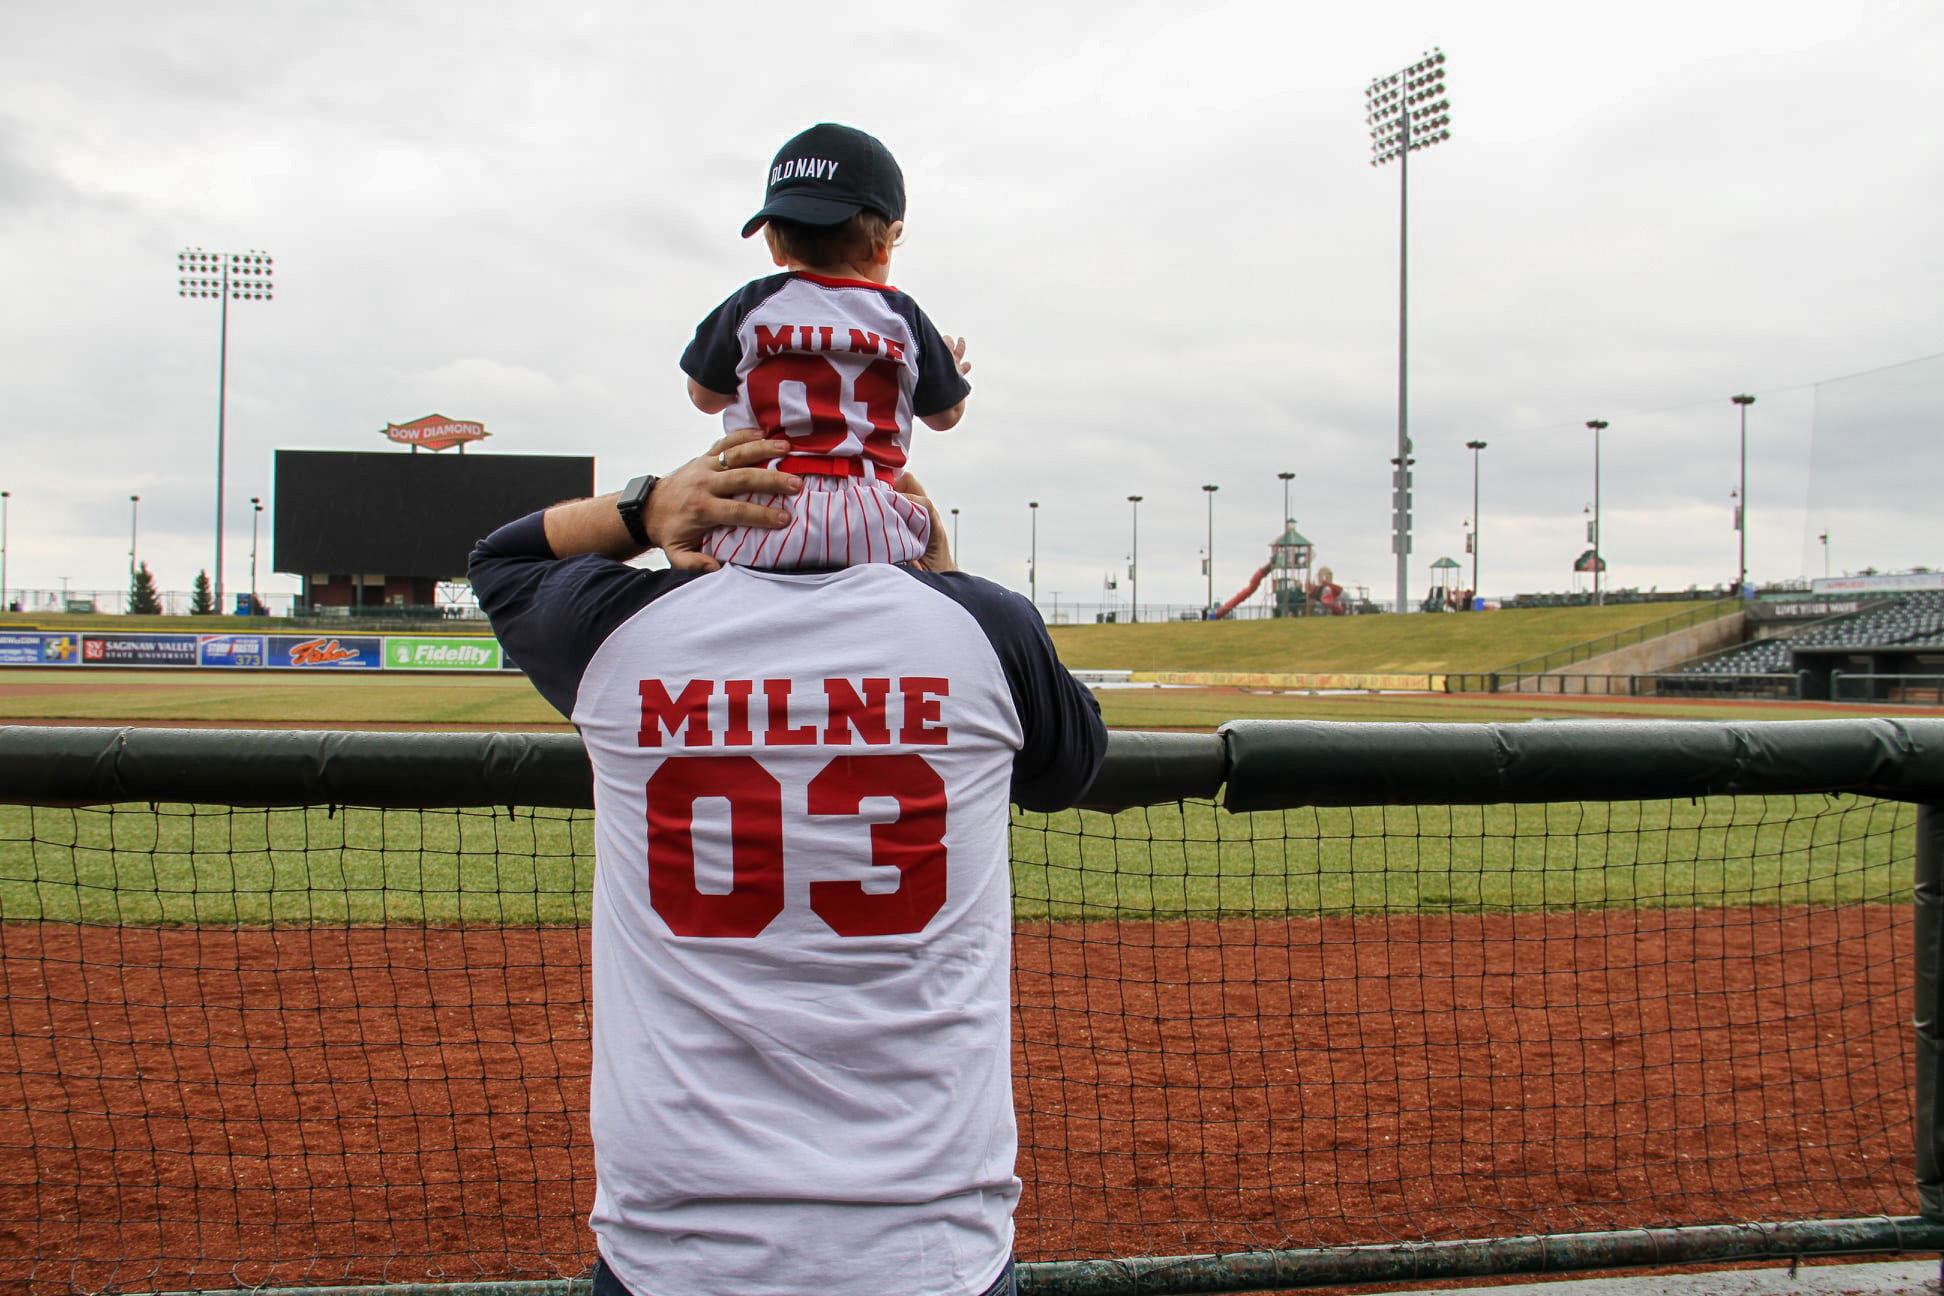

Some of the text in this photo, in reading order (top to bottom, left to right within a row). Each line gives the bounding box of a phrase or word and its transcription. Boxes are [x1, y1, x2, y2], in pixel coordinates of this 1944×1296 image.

[770, 157, 839, 187] OLD NAVY
[754, 324, 906, 361] MILNE
[747, 352, 907, 468] 01
[390, 423, 481, 439] DOW DIAMOND
[105, 640, 196, 652] SAGINAW VALLEY
[137, 652, 196, 660] UNIVERSITY
[415, 645, 492, 665] Fidelity
[235, 655, 260, 666] 373
[638, 677, 949, 747] MILNE
[646, 754, 948, 938] 03
